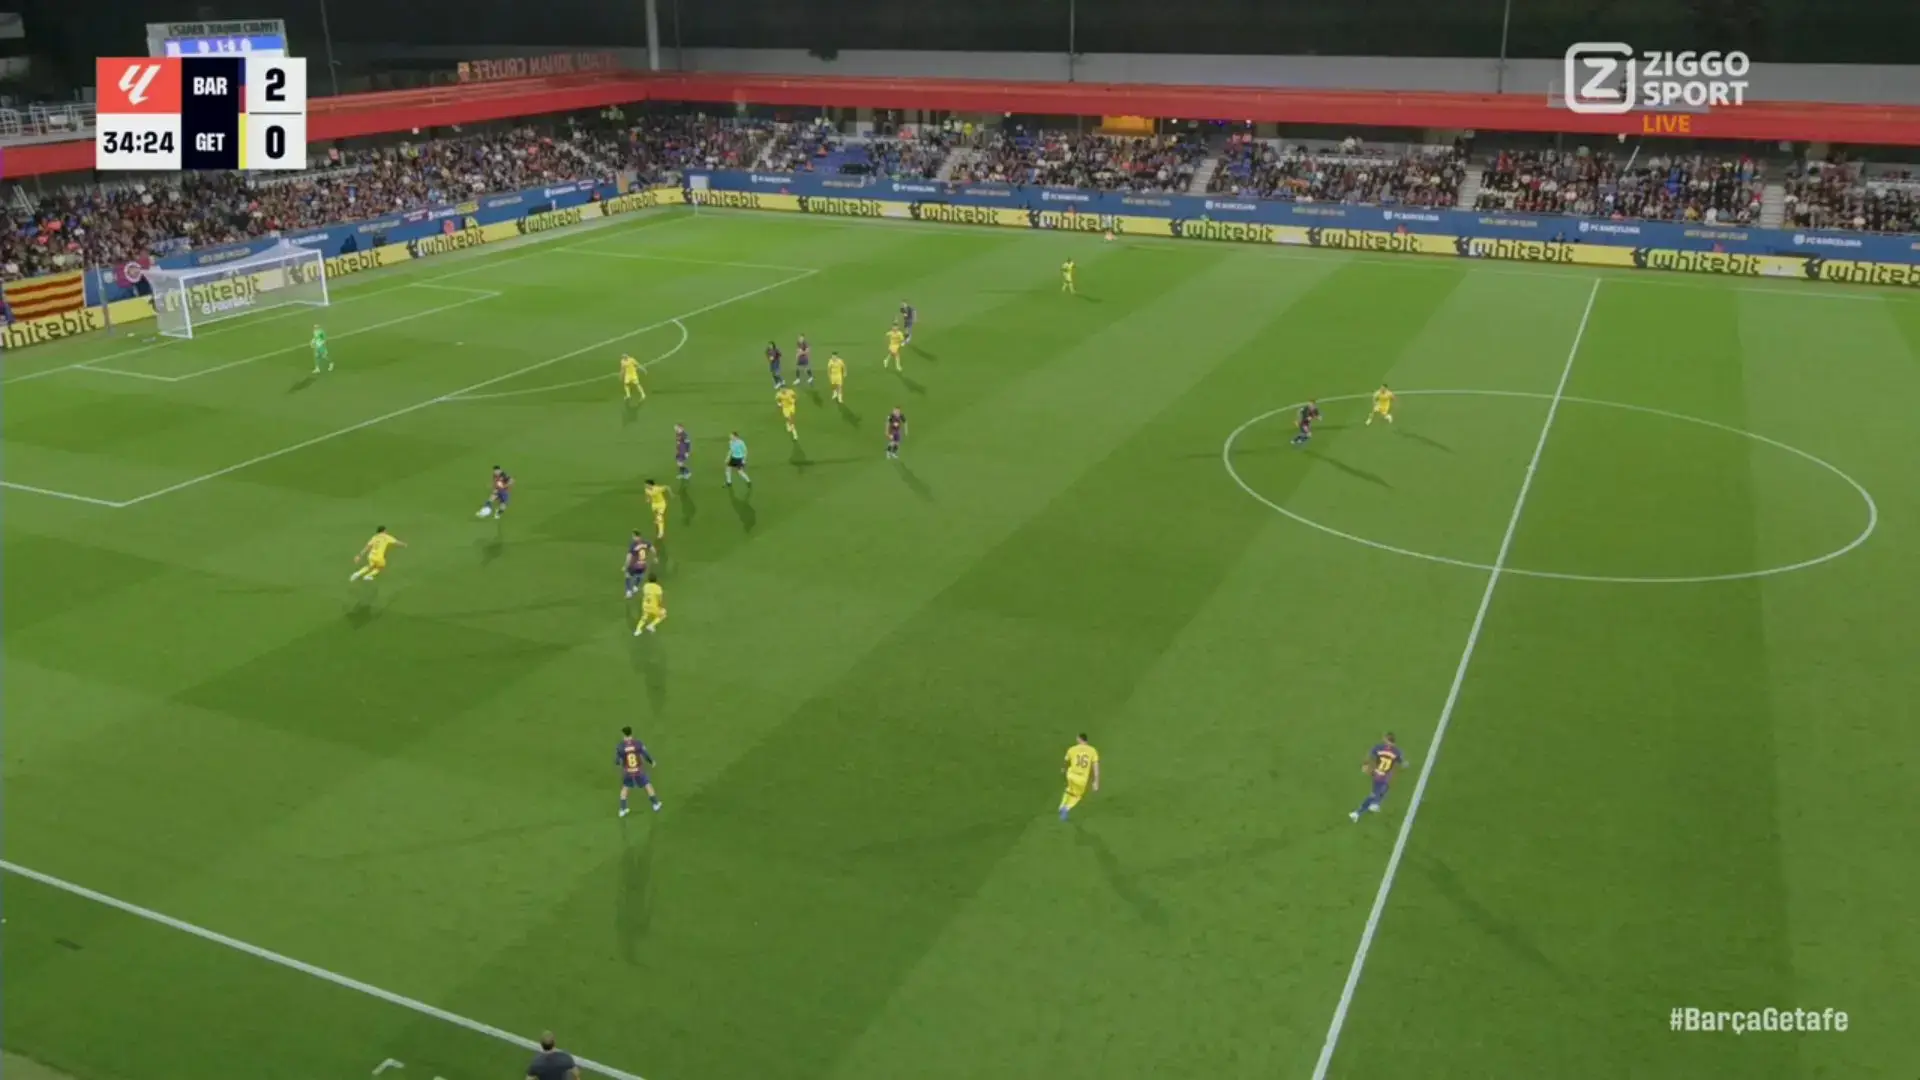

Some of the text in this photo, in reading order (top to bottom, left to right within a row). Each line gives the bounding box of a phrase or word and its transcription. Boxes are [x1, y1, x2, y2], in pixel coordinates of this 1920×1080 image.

[608, 192, 658, 216] whitebit
[693, 189, 760, 209] whitebit
[809, 196, 882, 217] whitebit
[530, 208, 581, 234] whitebit
[923, 201, 999, 225] whitebit
[420, 226, 487, 256] whitebit
[1187, 219, 1272, 243] whitebit
[1325, 228, 1418, 252] whitebit
[1472, 237, 1573, 262] whitebit
[308, 250, 383, 281] whitebit
[1653, 249, 1761, 276] whitebit
[627, 752, 637, 768] 8
[1076, 754, 1089, 768] 16
